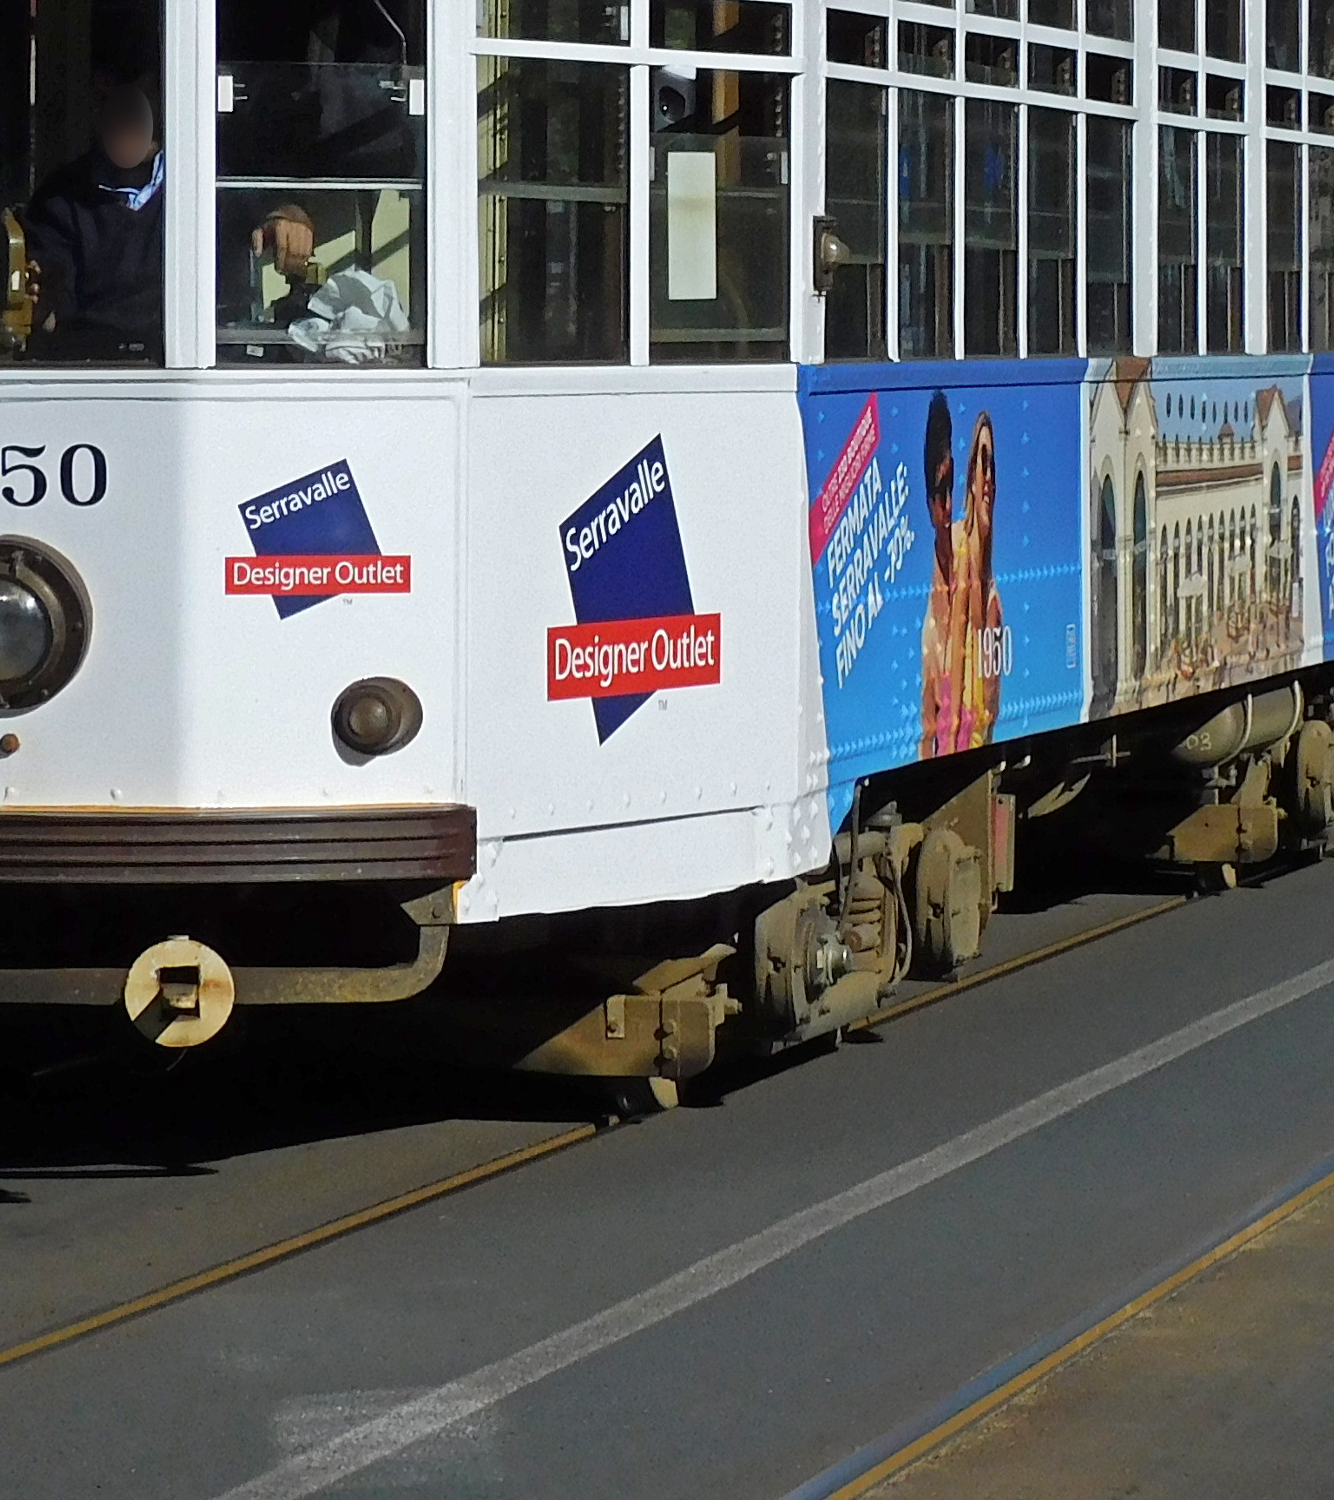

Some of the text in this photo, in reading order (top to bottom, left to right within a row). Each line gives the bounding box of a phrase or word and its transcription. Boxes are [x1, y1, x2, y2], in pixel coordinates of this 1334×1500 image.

[245, 471, 351, 529] Serravalle
[565, 459, 666, 571] Serravalle
[827, 456, 882, 588] FERMATA
[233, 560, 404, 590] Designer Outlet
[832, 462, 909, 637] SERRAVALLE:
[555, 625, 715, 687] Designer Outlet
[835, 604, 866, 689] FINO
[867, 572, 884, 630] AL
[977, 625, 1013, 679] 1950
